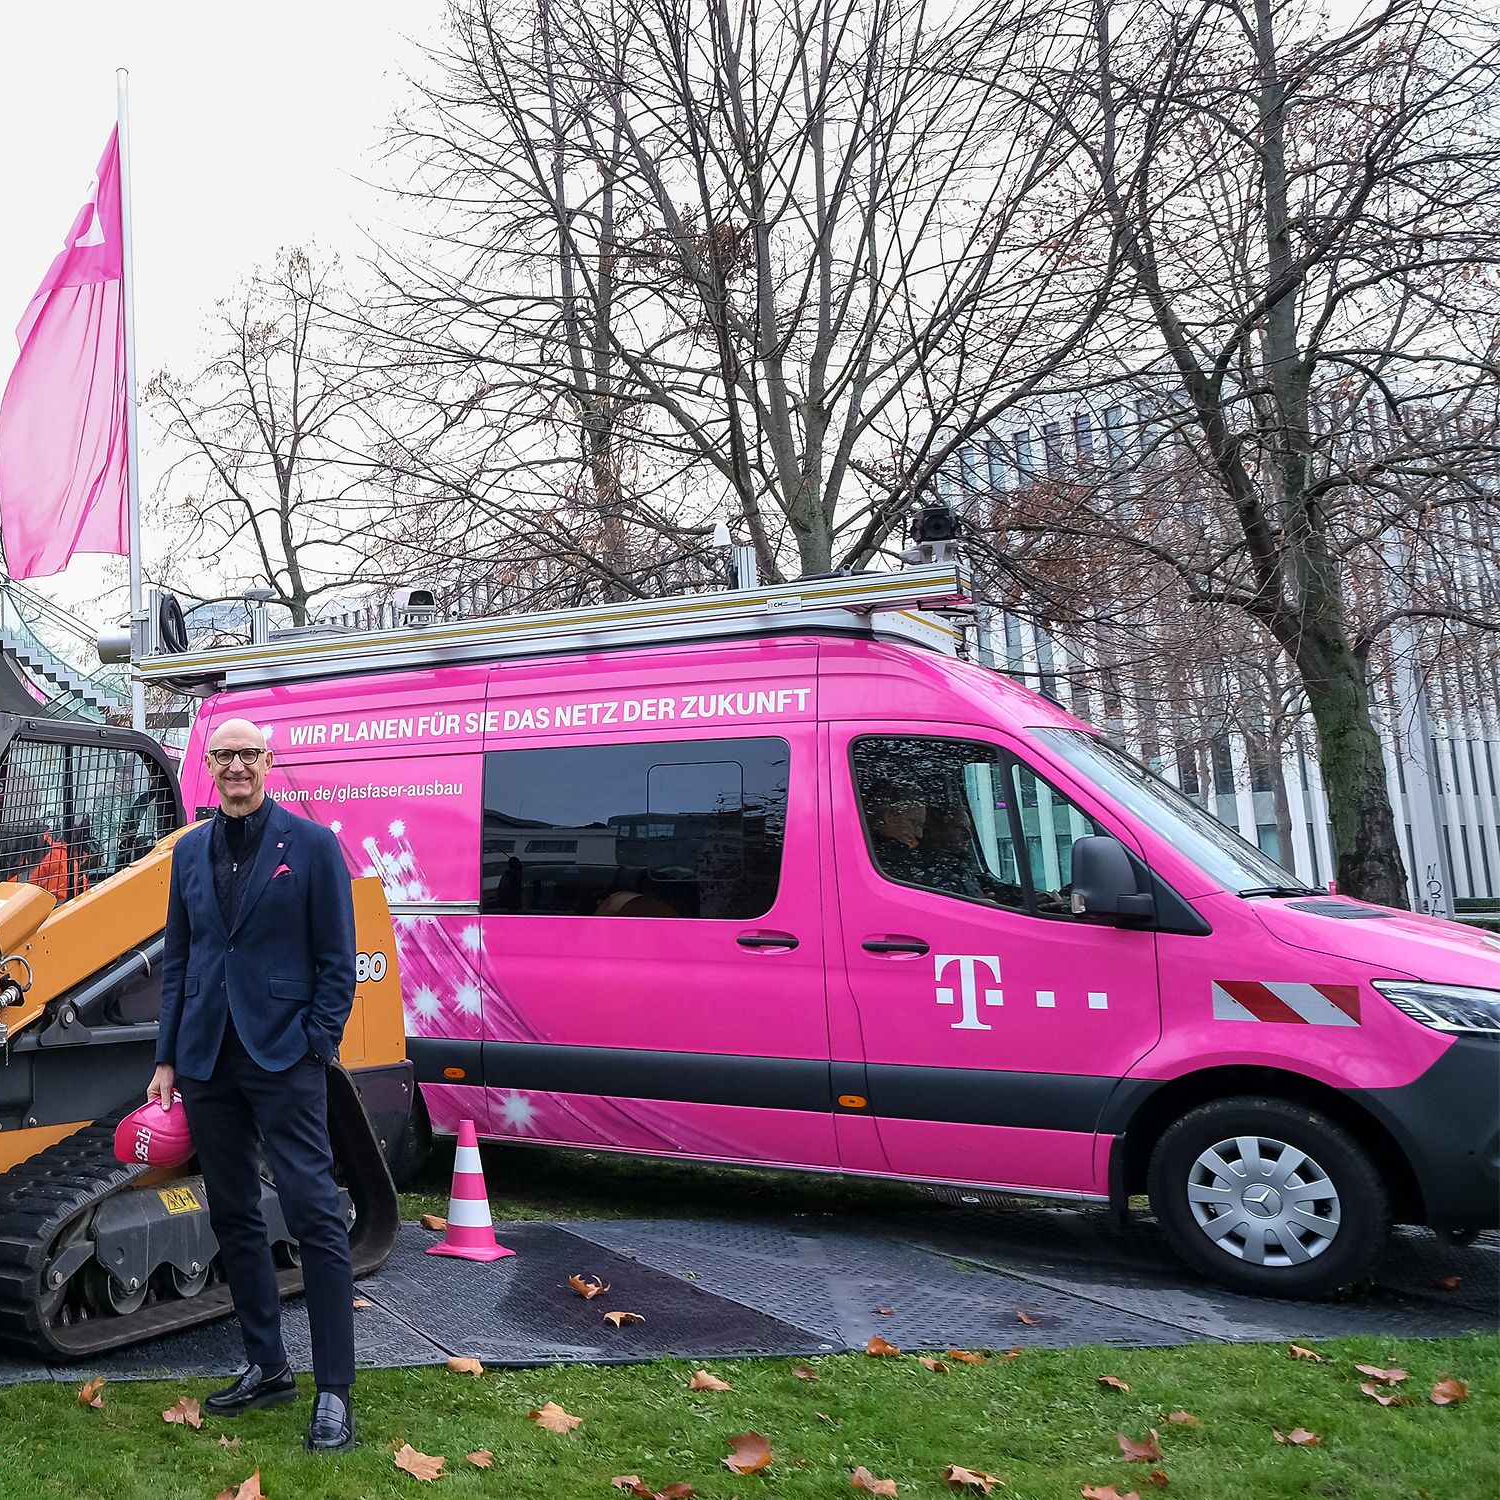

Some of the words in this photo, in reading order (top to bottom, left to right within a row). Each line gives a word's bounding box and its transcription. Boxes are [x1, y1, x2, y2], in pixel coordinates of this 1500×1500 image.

[289, 724, 327, 746] WIR
[330, 717, 414, 743] PLANEN
[417, 711, 460, 737] FÜR
[464, 711, 499, 734] SIE
[503, 707, 550, 731] DAS
[554, 701, 619, 728] NETZ
[623, 697, 675, 722] DER
[680, 688, 811, 719] ZUKUNFT
